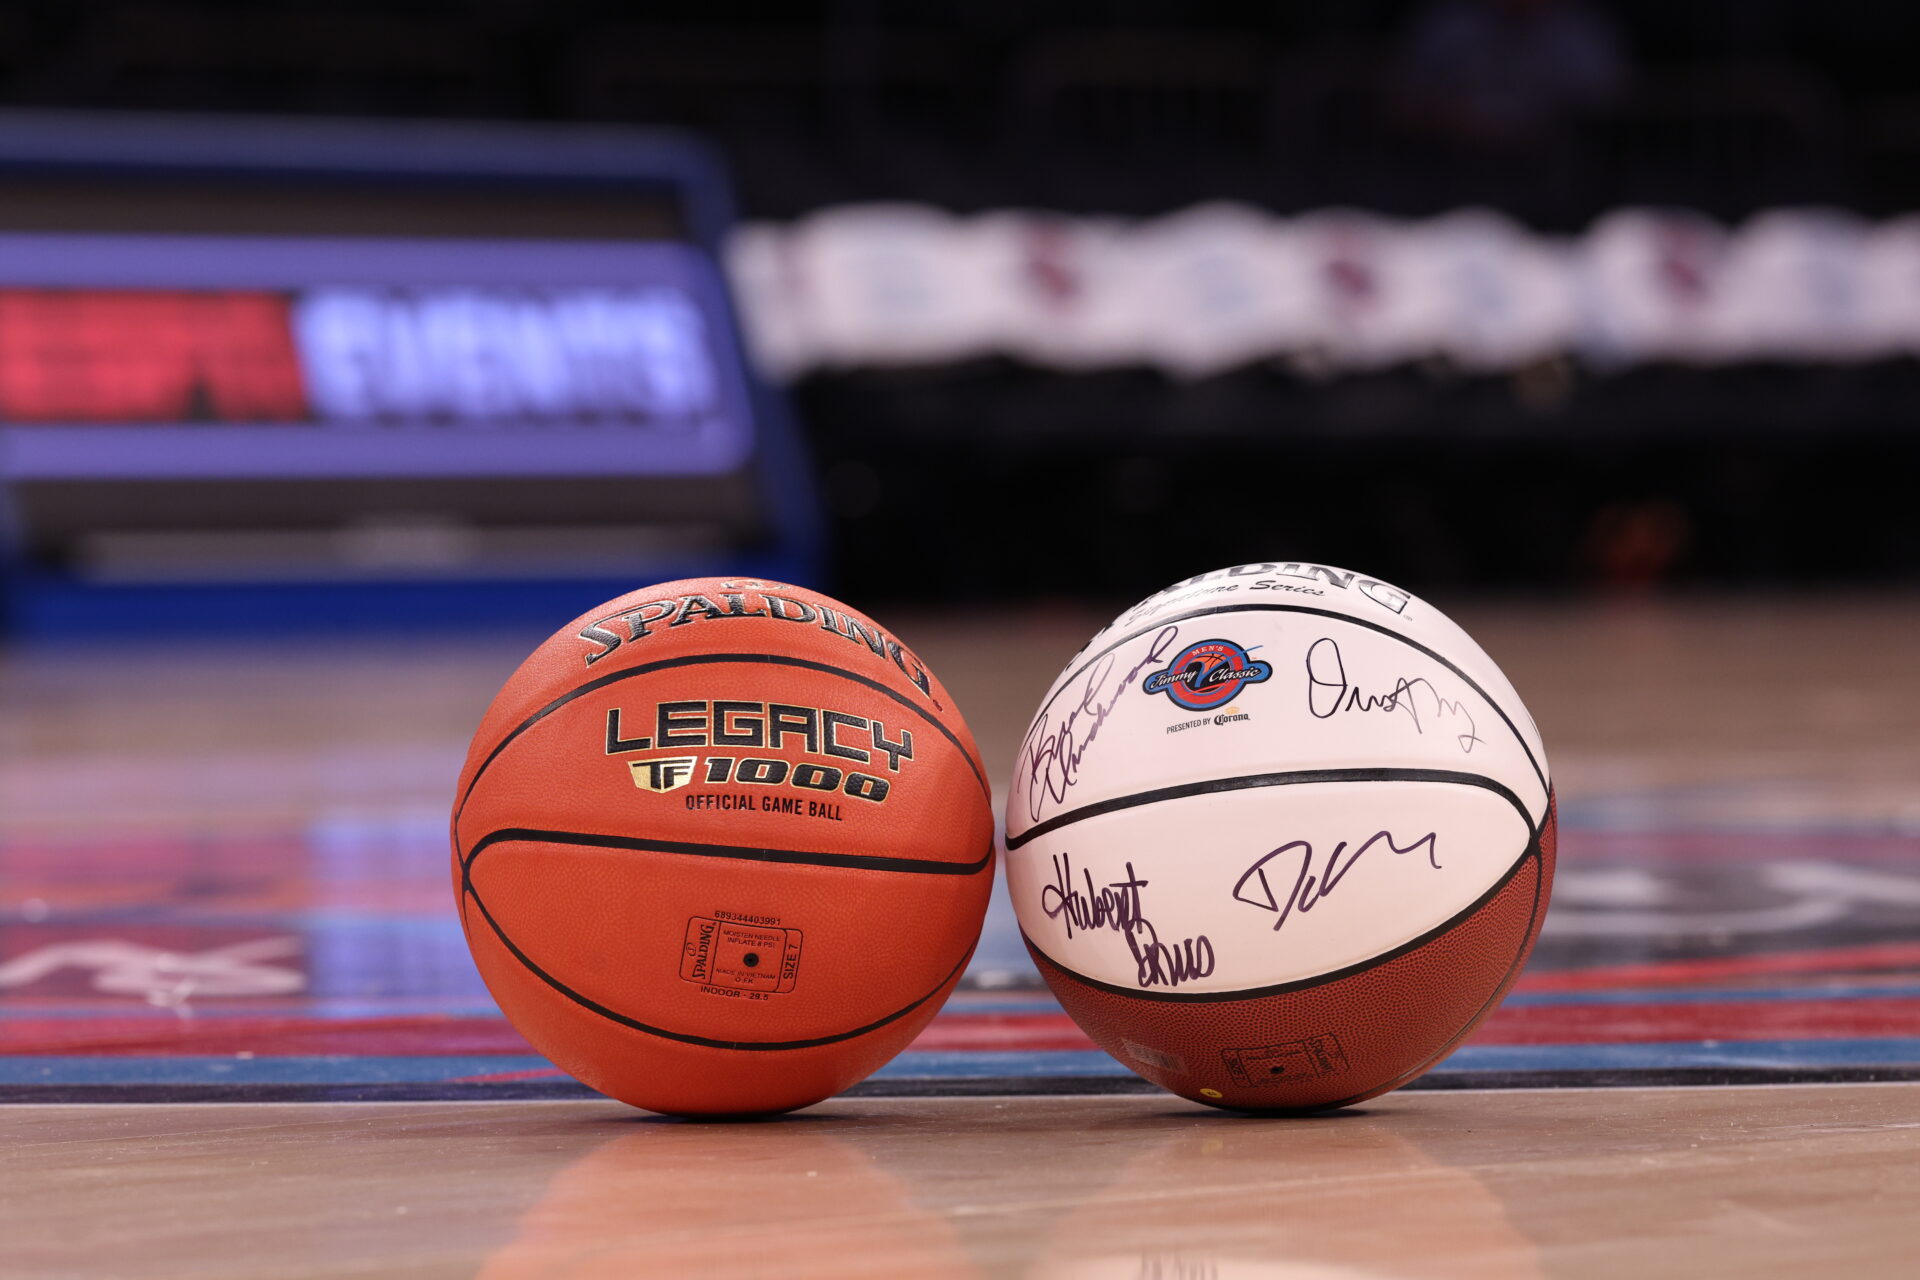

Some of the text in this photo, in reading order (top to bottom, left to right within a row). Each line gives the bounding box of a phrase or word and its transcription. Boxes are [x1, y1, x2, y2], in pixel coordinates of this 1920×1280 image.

[1249, 580, 1326, 597] Series
[579, 592, 934, 701] SPALDING
[1191, 644, 1224, 657] MEN'S
[1150, 670, 1198, 689] Jimmy
[1208, 666, 1261, 683] Classic
[605, 699, 915, 774] LEGACY
[1166, 713, 1249, 735] PRESENTED BY Corona
[629, 756, 891, 804] TF 1000
[685, 794, 843, 821] OFFICIAL GAME BALL
[692, 924, 716, 980] SPALDING
[727, 936, 758, 947] INFLATE
[763, 941, 776, 949] PSI
[783, 953, 797, 980] SIZE
[700, 985, 769, 1001] INDOOR 29.5
